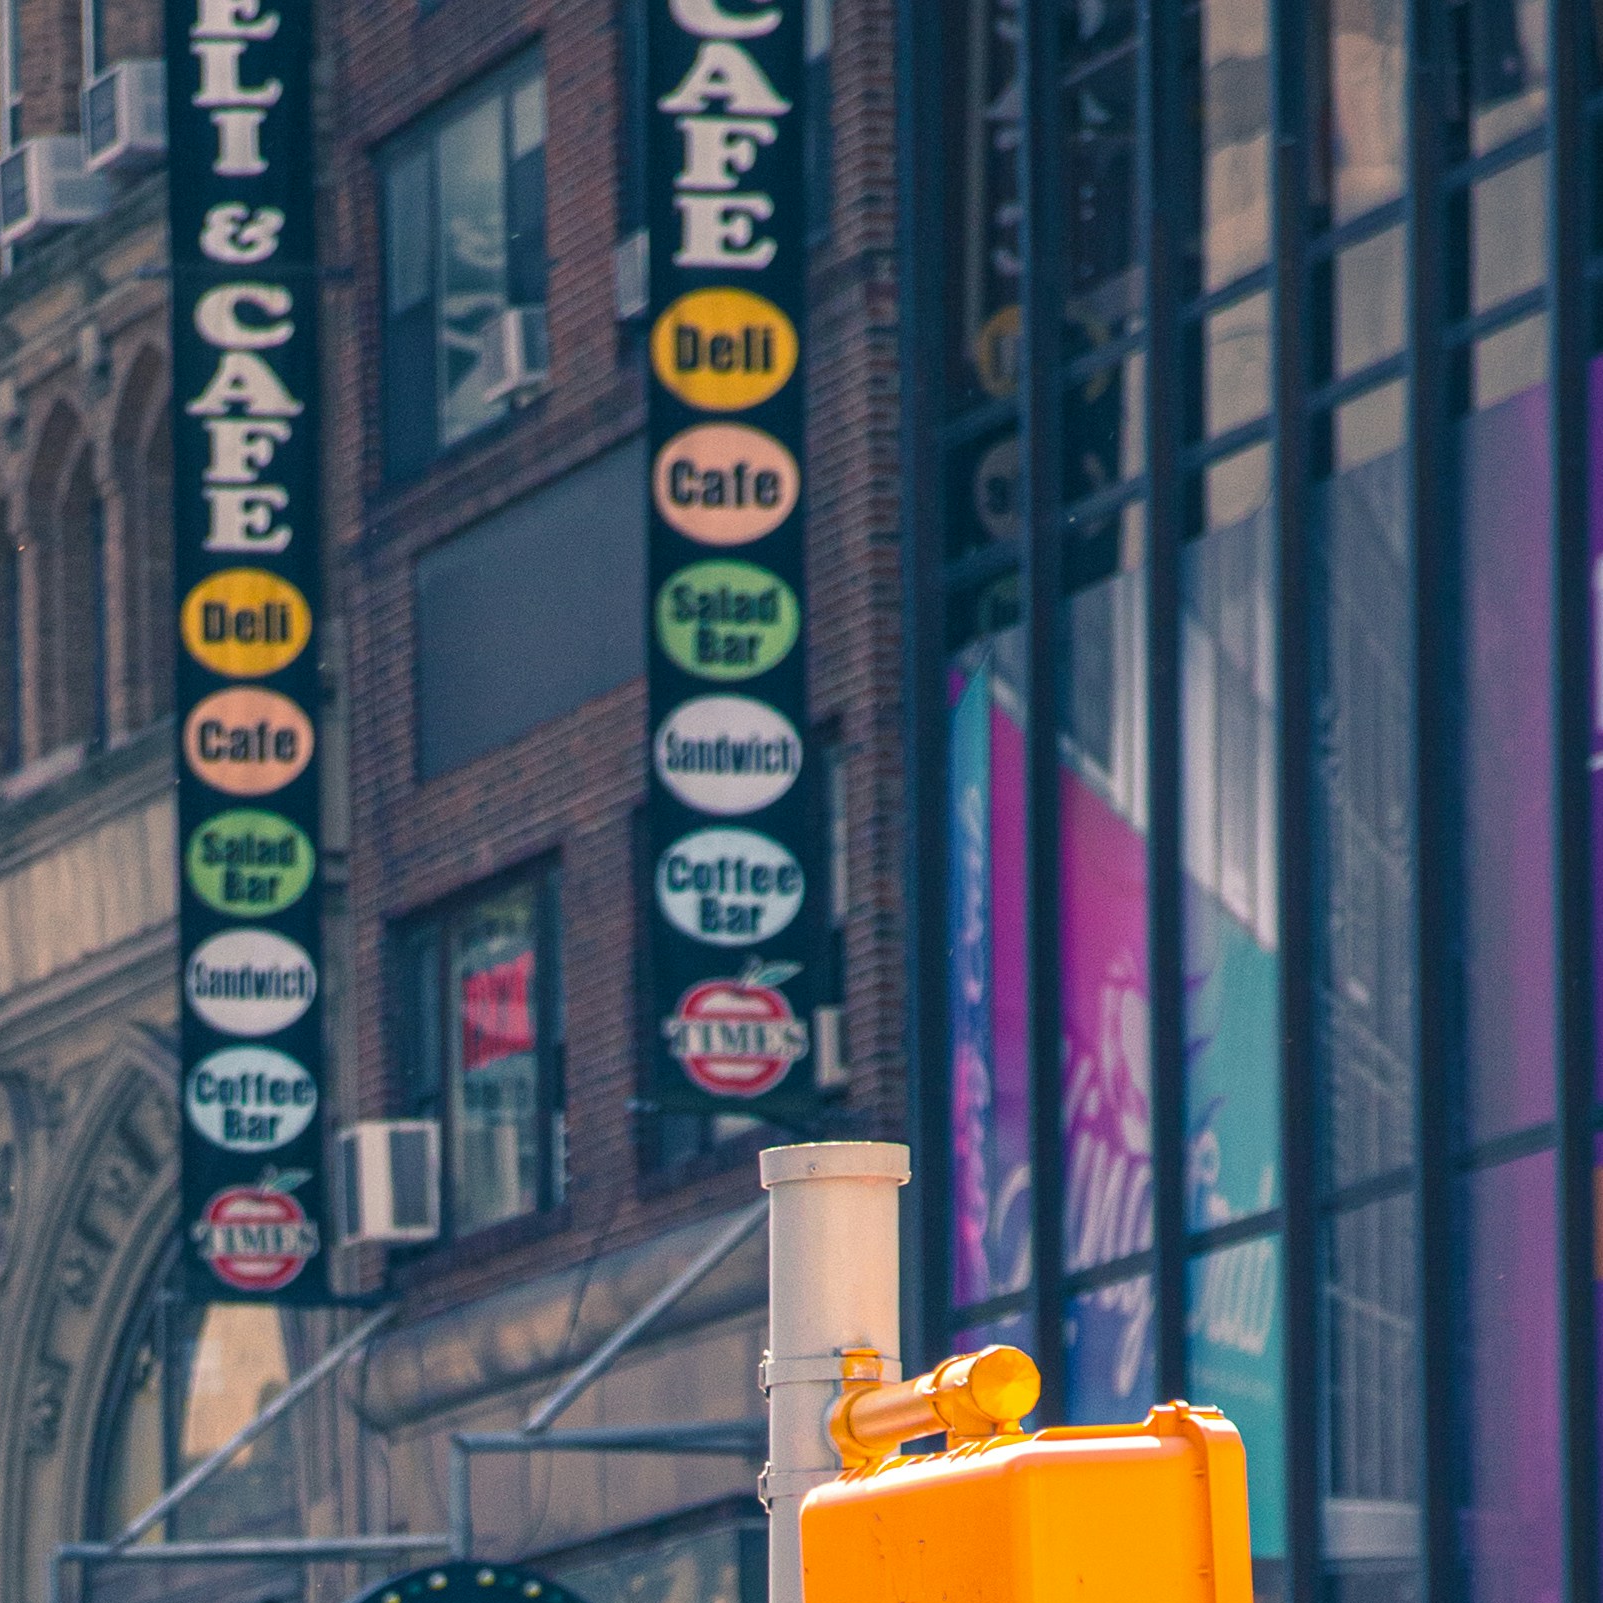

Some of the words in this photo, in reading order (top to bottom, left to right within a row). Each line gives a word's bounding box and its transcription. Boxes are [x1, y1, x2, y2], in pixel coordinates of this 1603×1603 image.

[200, 203, 285, 264] &
[673, 325, 777, 375] Deli
[186, 281, 304, 552] CAFE
[668, 458, 780, 507] Cafe
[202, 601, 291, 643] Deli
[669, 582, 780, 625] Salad
[695, 624, 762, 666] Bar
[197, 721, 297, 762] Cafe
[664, 734, 796, 776] Sandwich
[200, 830, 296, 867] Salad
[223, 866, 281, 902] Bar
[665, 854, 798, 897] Coffee
[696, 894, 763, 937] Bar
[192, 963, 310, 1001] Sandwich
[665, 1016, 809, 1057] TIMES
[196, 1072, 312, 1107] Coffee
[223, 1107, 282, 1143] Bar
[193, 1221, 317, 1258] TIMES
